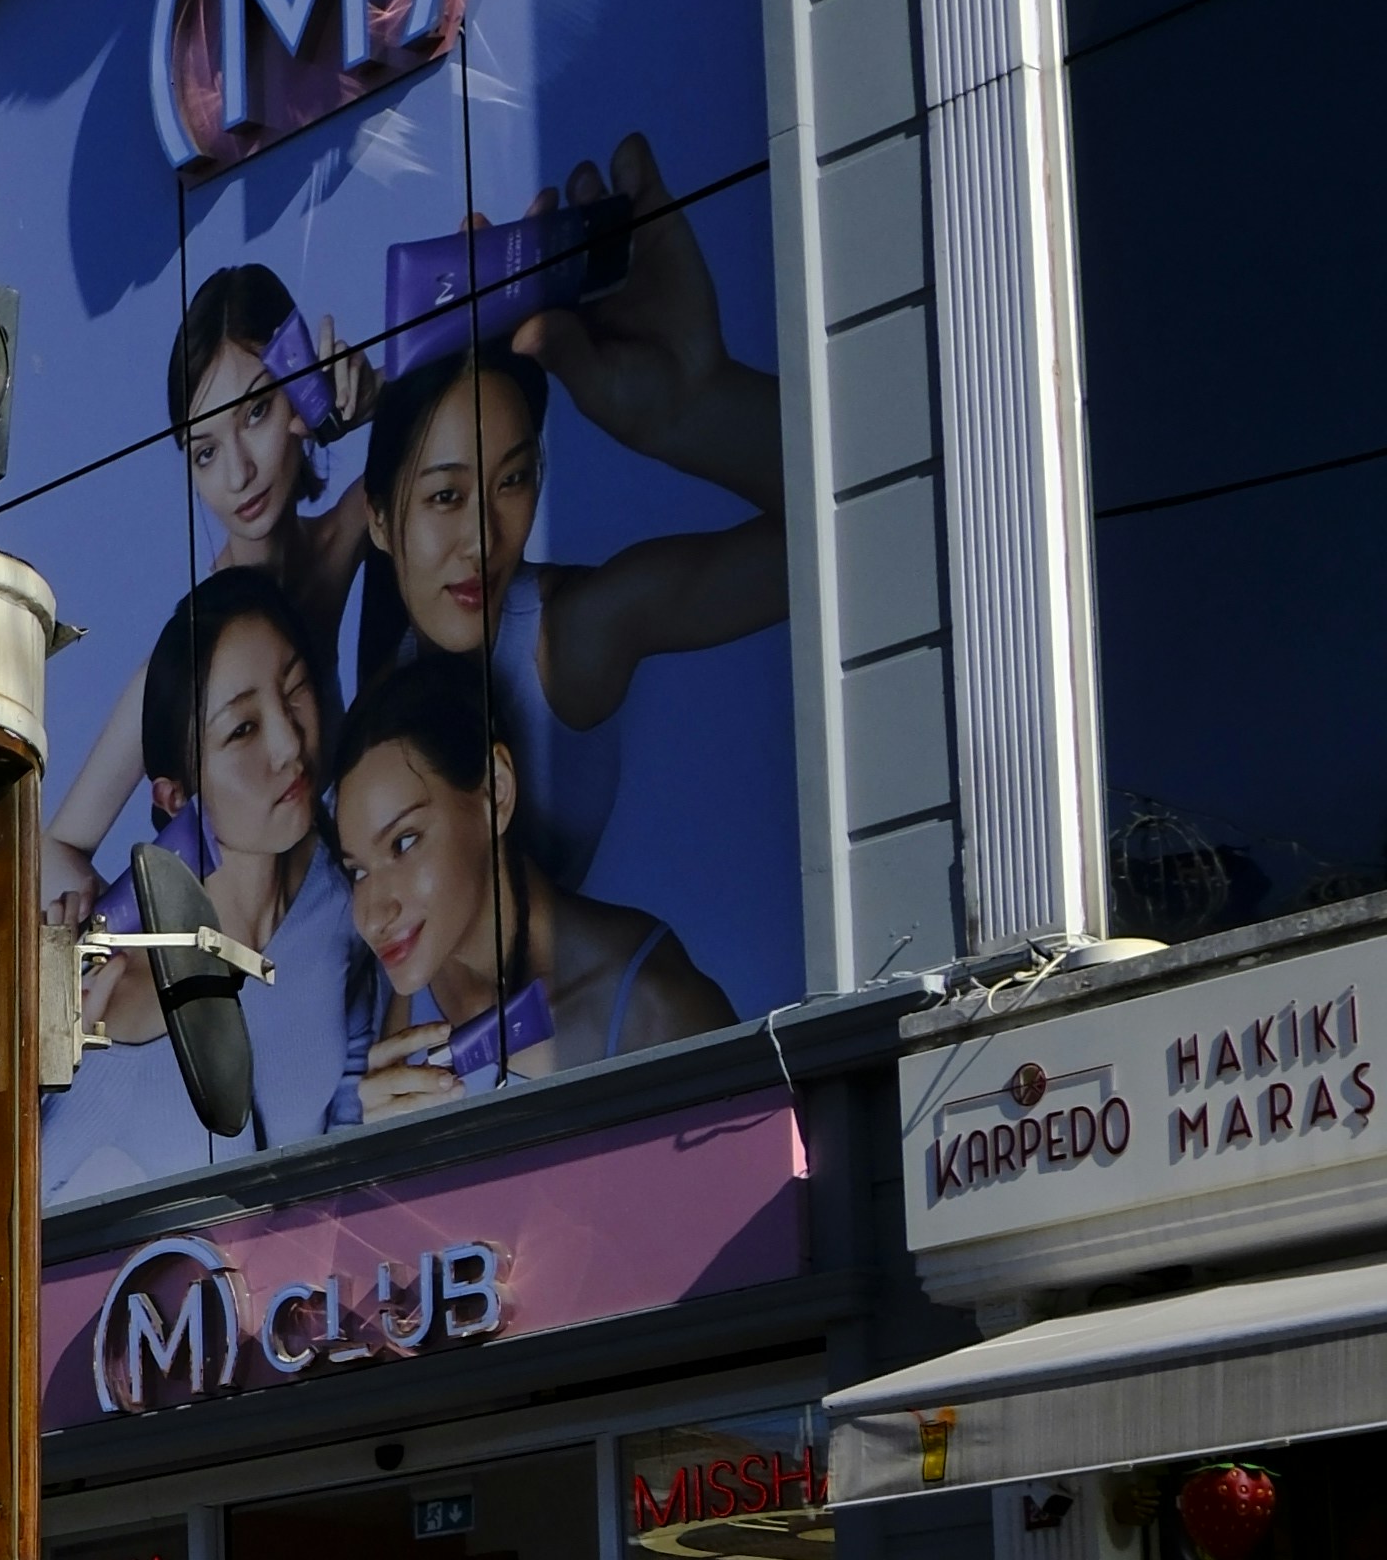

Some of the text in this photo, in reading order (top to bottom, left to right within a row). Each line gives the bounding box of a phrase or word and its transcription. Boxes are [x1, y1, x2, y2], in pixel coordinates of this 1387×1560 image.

[1177, 984, 1358, 1085] HAKİKİ
[934, 1096, 1131, 1197] KARPEDO
[1178, 1061, 1376, 1154] MARAŞ
[262, 1240, 502, 1374] CLUB
